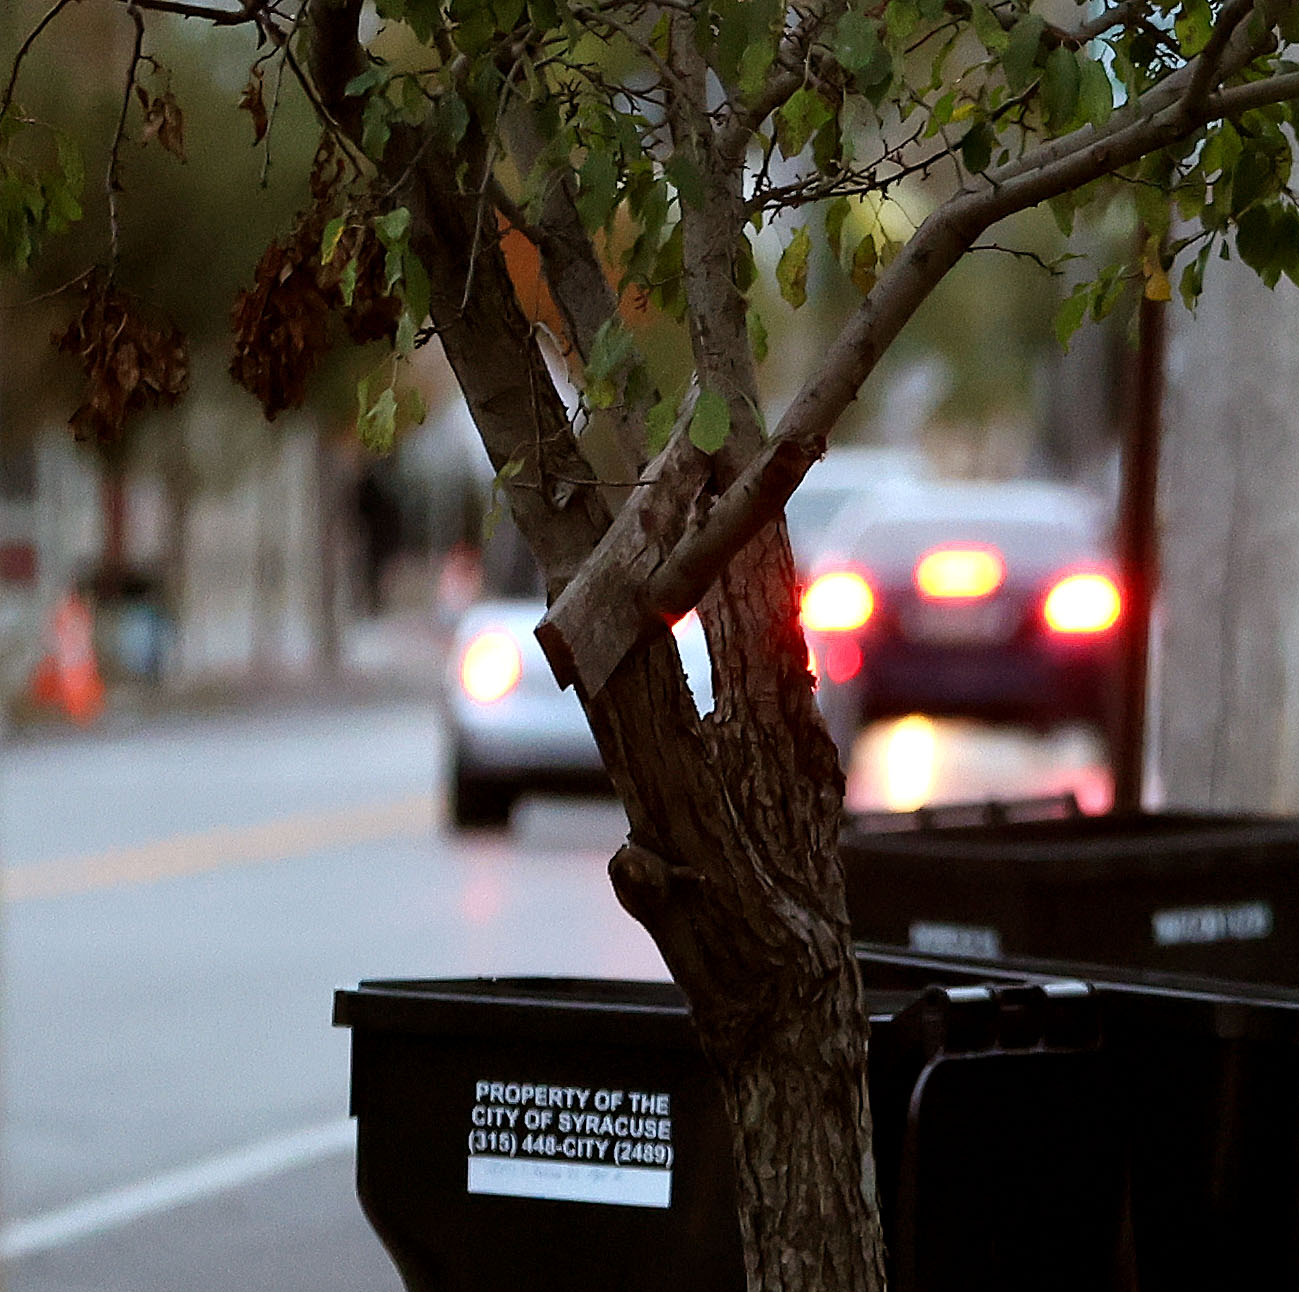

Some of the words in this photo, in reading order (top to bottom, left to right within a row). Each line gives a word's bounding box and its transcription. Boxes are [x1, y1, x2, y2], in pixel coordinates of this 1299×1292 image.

[476, 1080, 590, 1109] PROPERTY
[595, 1089, 624, 1112] OF
[628, 1093, 670, 1116] THE
[472, 1104, 520, 1127] CITY
[525, 1108, 553, 1130] OF
[559, 1110, 671, 1140] SYRACUSE
